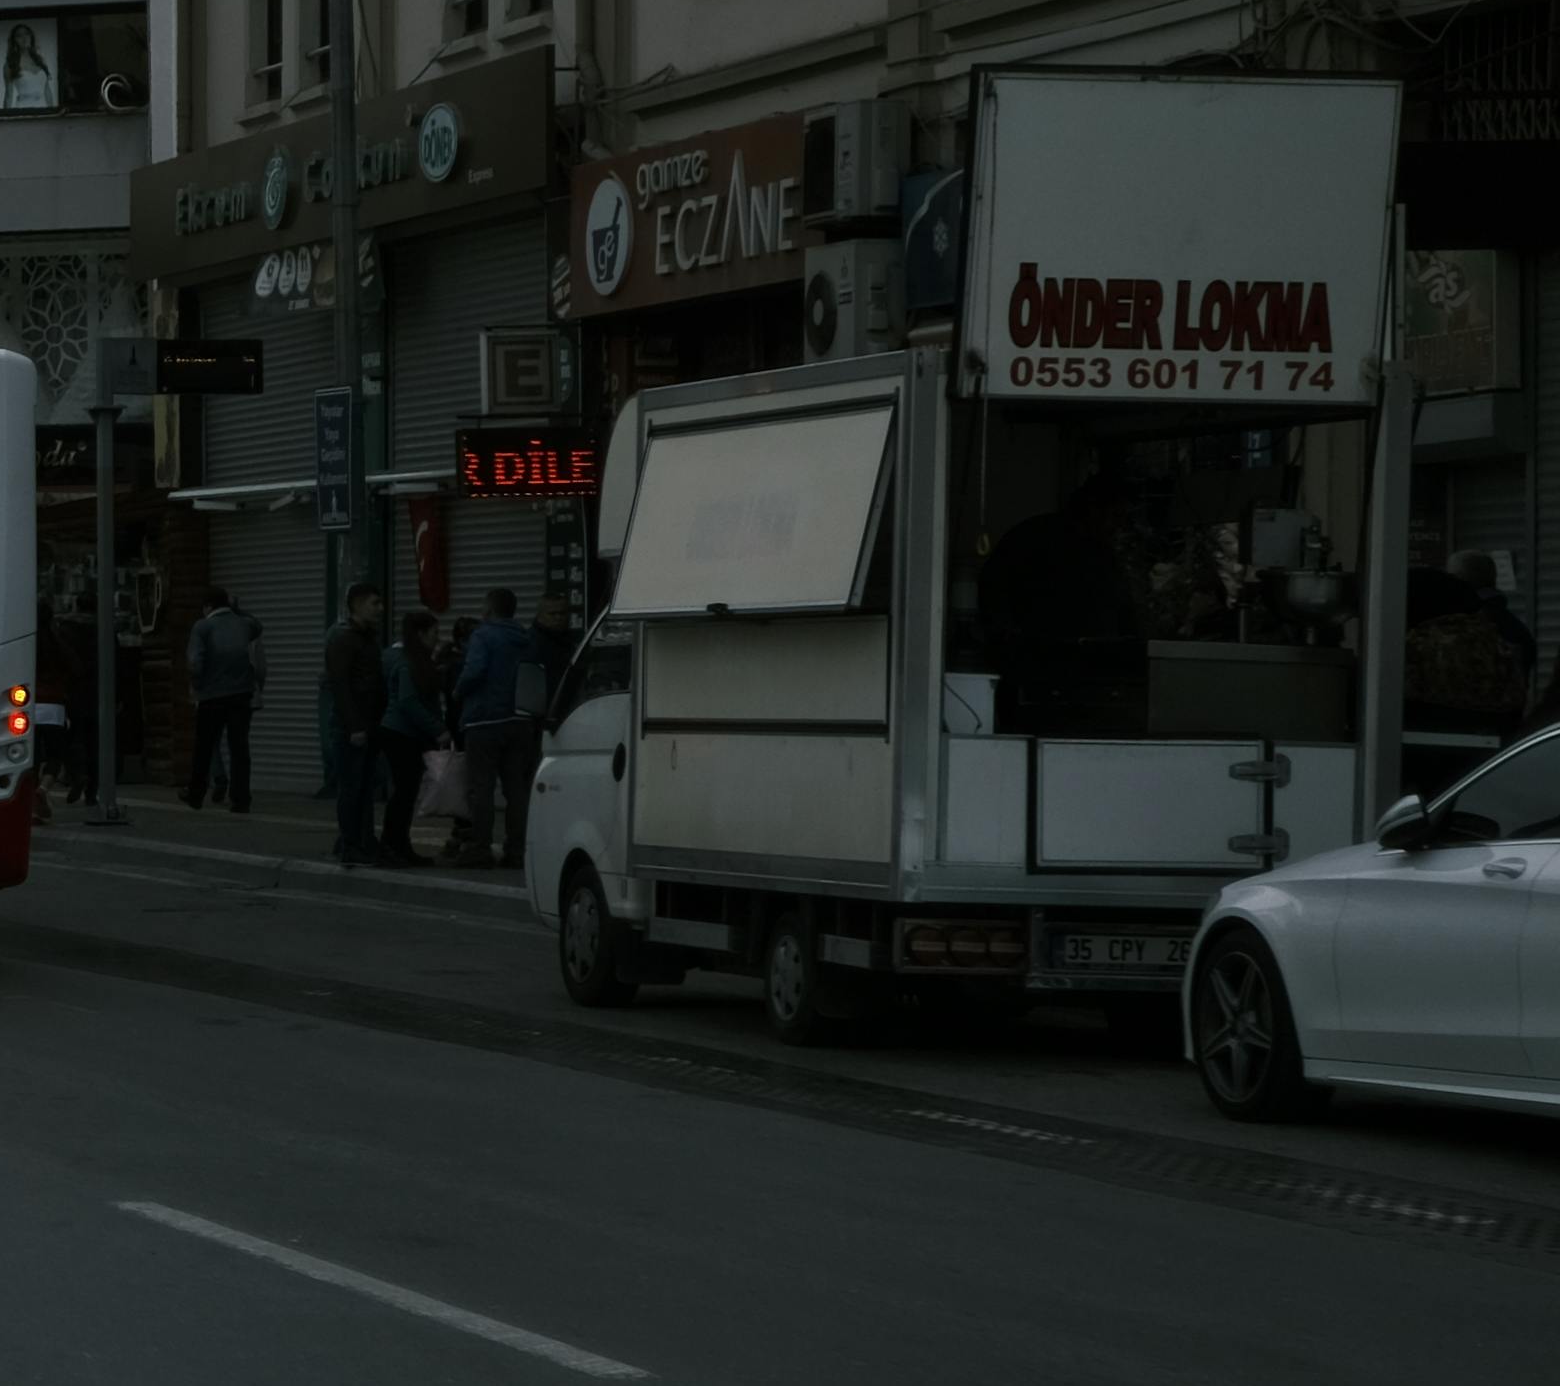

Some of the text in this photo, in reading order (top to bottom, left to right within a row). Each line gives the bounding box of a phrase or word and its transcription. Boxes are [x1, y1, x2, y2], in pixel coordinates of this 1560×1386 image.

[636, 149, 710, 211] gamze
[655, 148, 798, 276] ECZANE
[1009, 261, 1334, 354] ÖNDER LOKMA
[1009, 356, 1335, 392] 0553 601 71 74
[1067, 938, 1092, 962] 35
[1108, 939, 1145, 963] CPY
